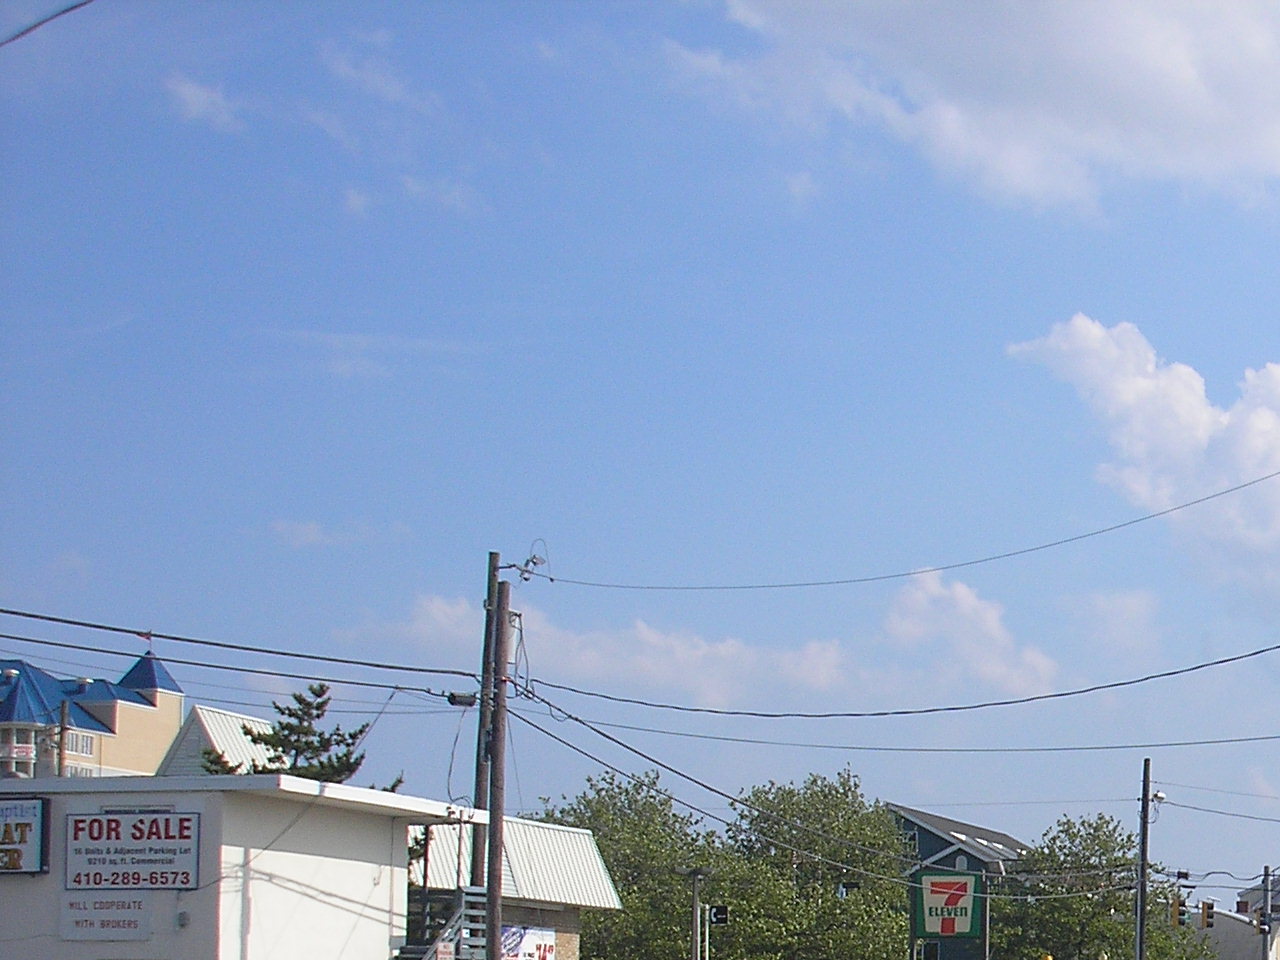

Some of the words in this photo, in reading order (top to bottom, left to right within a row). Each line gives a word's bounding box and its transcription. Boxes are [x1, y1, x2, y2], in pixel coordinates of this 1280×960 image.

[73, 818, 122, 841] FOR
[131, 817, 192, 840] SALE
[114, 847, 147, 856] Adjacent
[148, 847, 177, 856] Parking
[179, 846, 192, 854] Lot
[131, 856, 175, 865] Commercial
[73, 871, 191, 885] 410-289-6573
[69, 901, 88, 910] WILL
[93, 900, 143, 910] COOPERATE
[930, 881, 968, 933] 7
[75, 919, 96, 929] WITH
[100, 919, 139, 929] BROKERS
